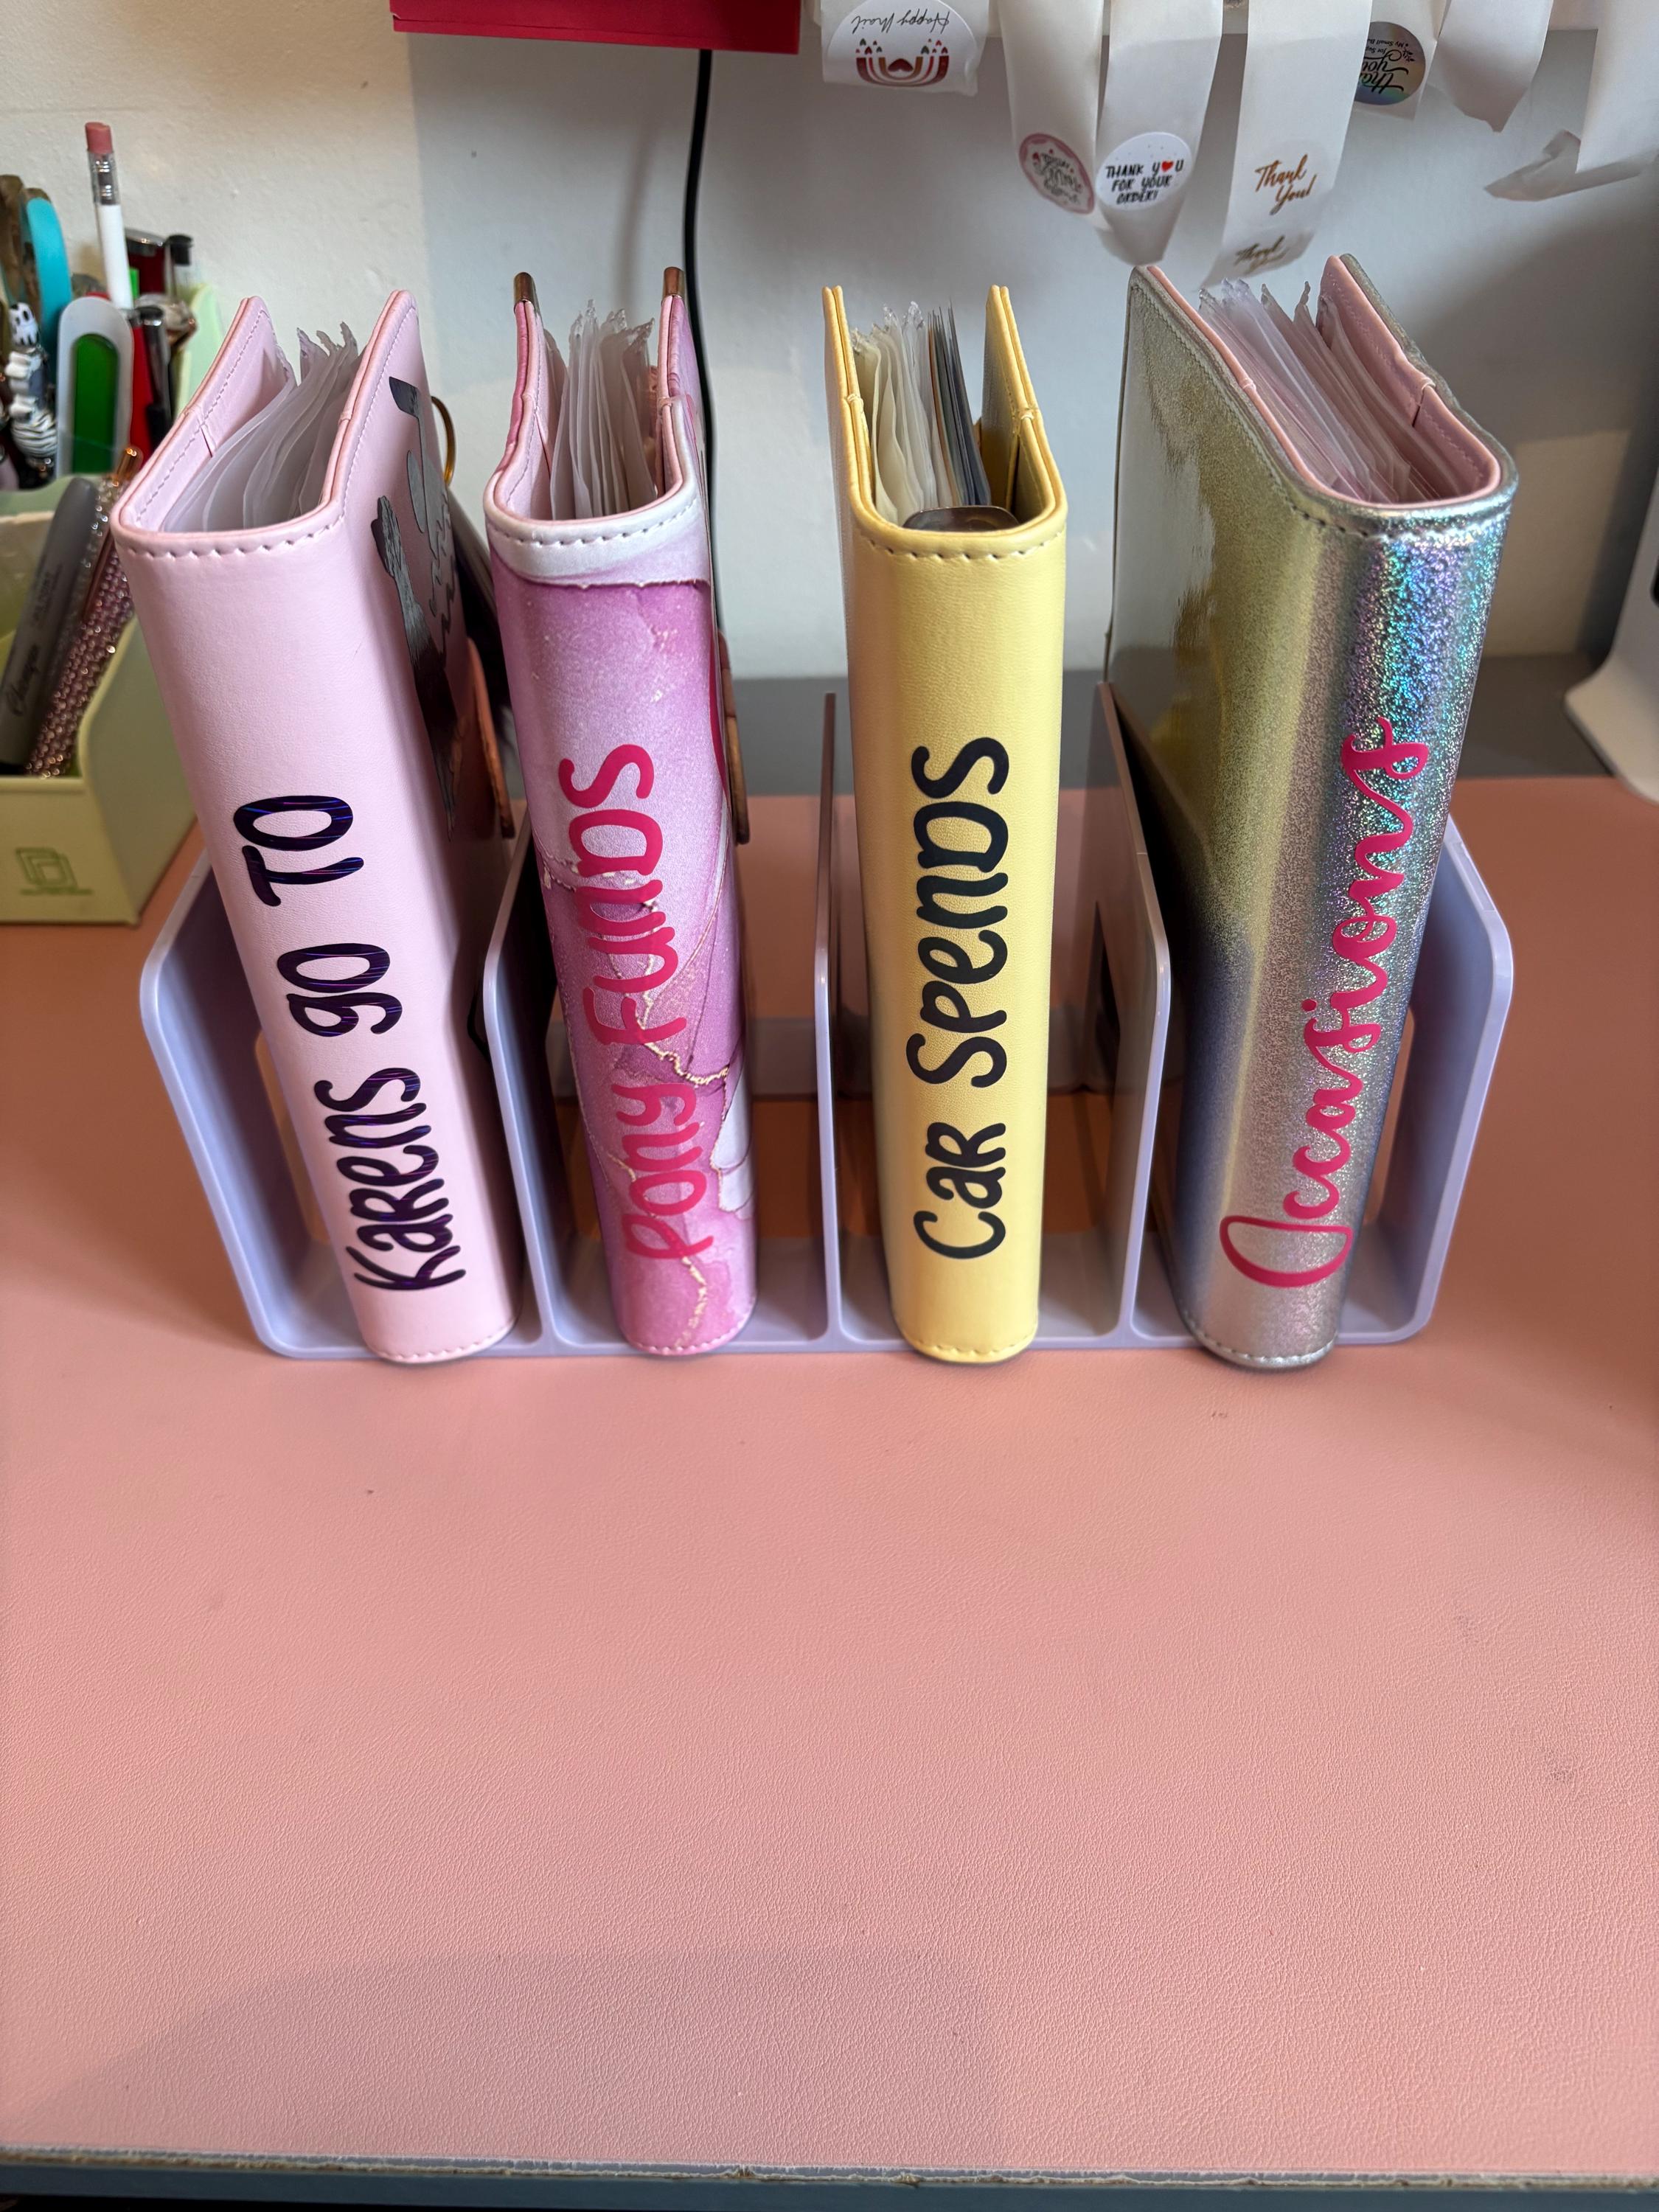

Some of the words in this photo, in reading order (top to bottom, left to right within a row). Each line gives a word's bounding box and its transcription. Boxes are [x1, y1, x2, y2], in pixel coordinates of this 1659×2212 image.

[850, 12, 895, 35] Mail
[897, 9, 950, 35] Happy
[1359, 73, 1405, 95] tha
[1105, 164, 1144, 179] THANK
[1254, 154, 1309, 192] Thank
[1111, 179, 1135, 192] FOR
[1141, 175, 1173, 192] YOUR
[1220, 717, 1429, 1287] Occasions
